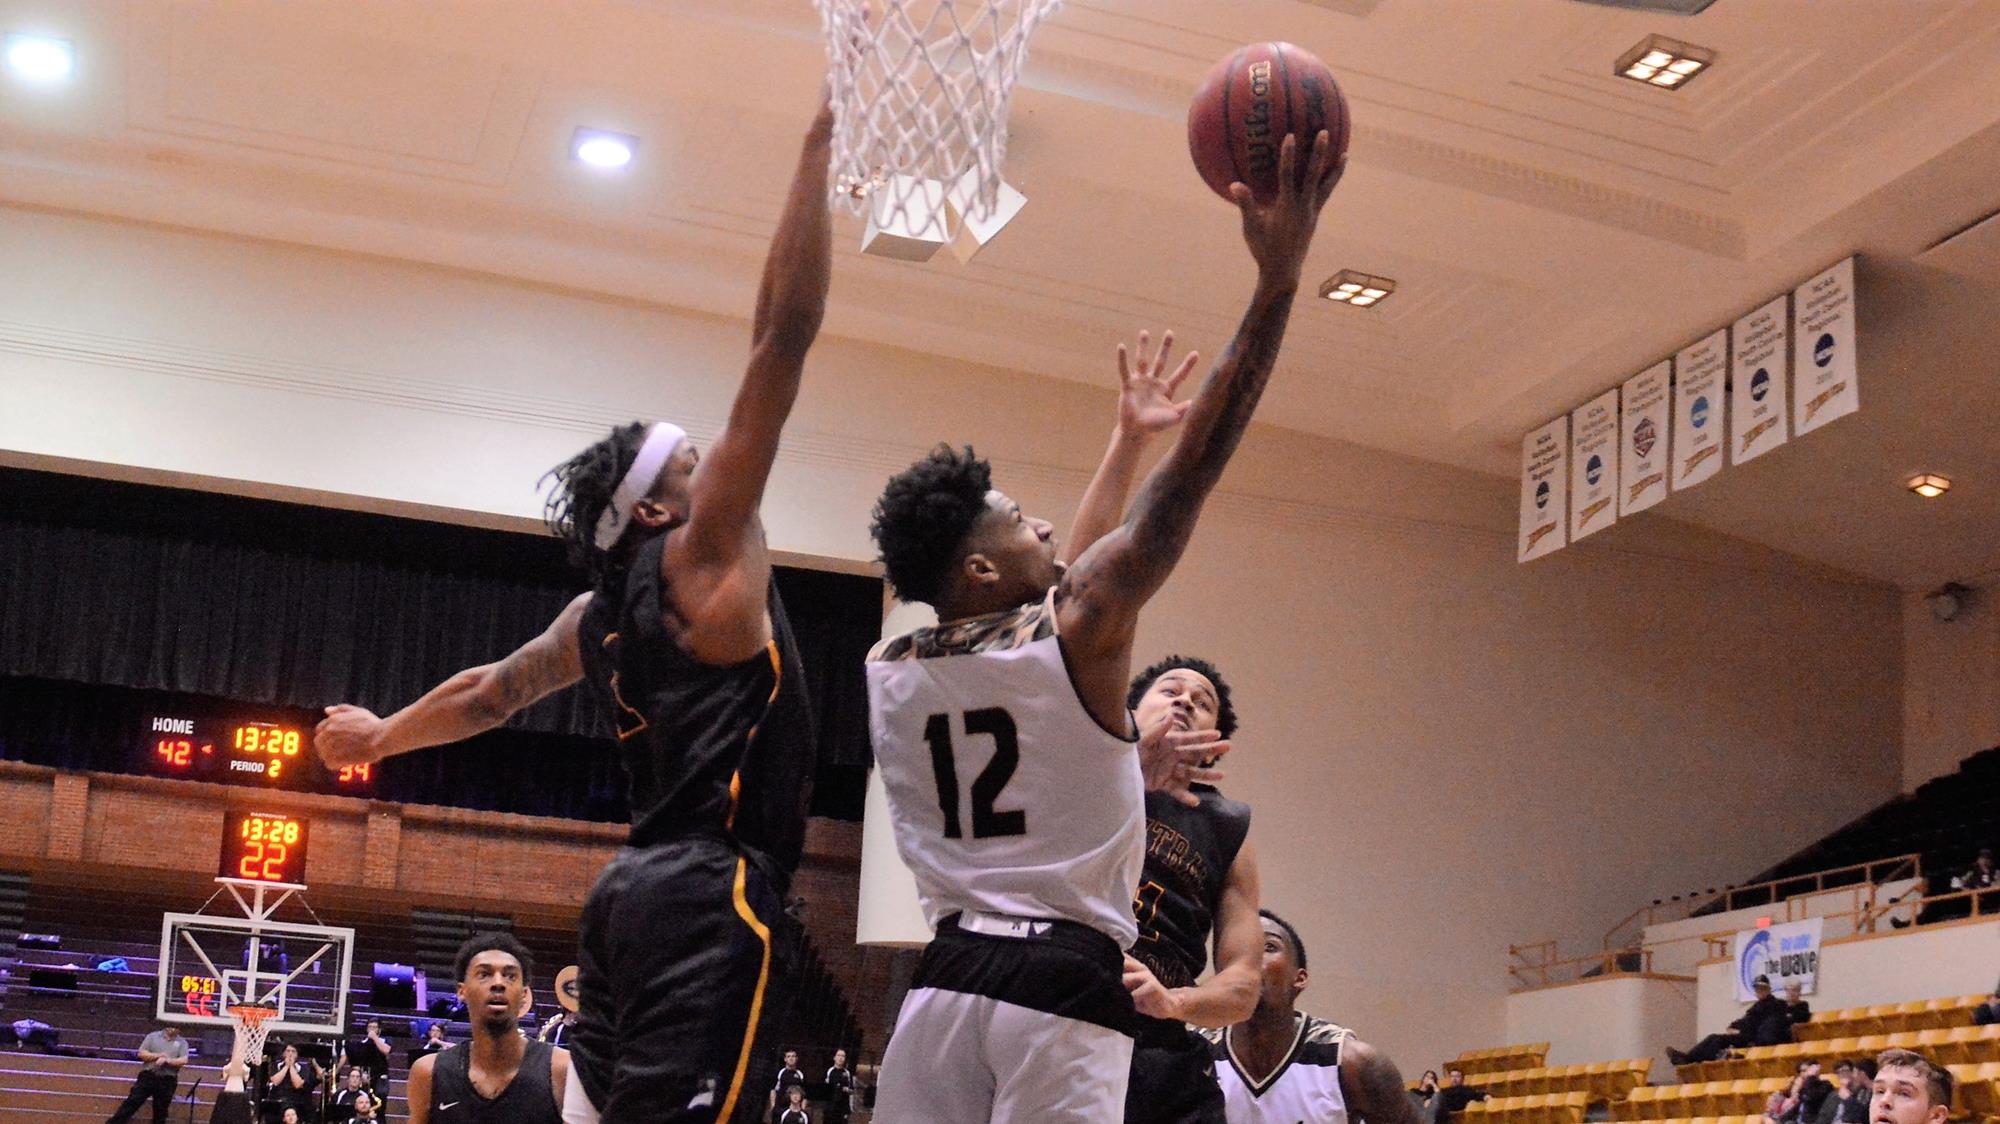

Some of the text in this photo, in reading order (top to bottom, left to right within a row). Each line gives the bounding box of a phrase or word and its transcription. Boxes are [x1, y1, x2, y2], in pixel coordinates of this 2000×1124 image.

[1246, 61, 1273, 178] Wilson
[152, 717, 194, 734] HOME
[158, 740, 191, 766] 42
[235, 727, 299, 756] 13:28
[230, 759, 281, 778] PERIOD 2
[924, 706, 1026, 839] 12
[242, 818, 299, 844] 13:28
[239, 841, 287, 880] 22
[1780, 951, 1817, 977] wave
